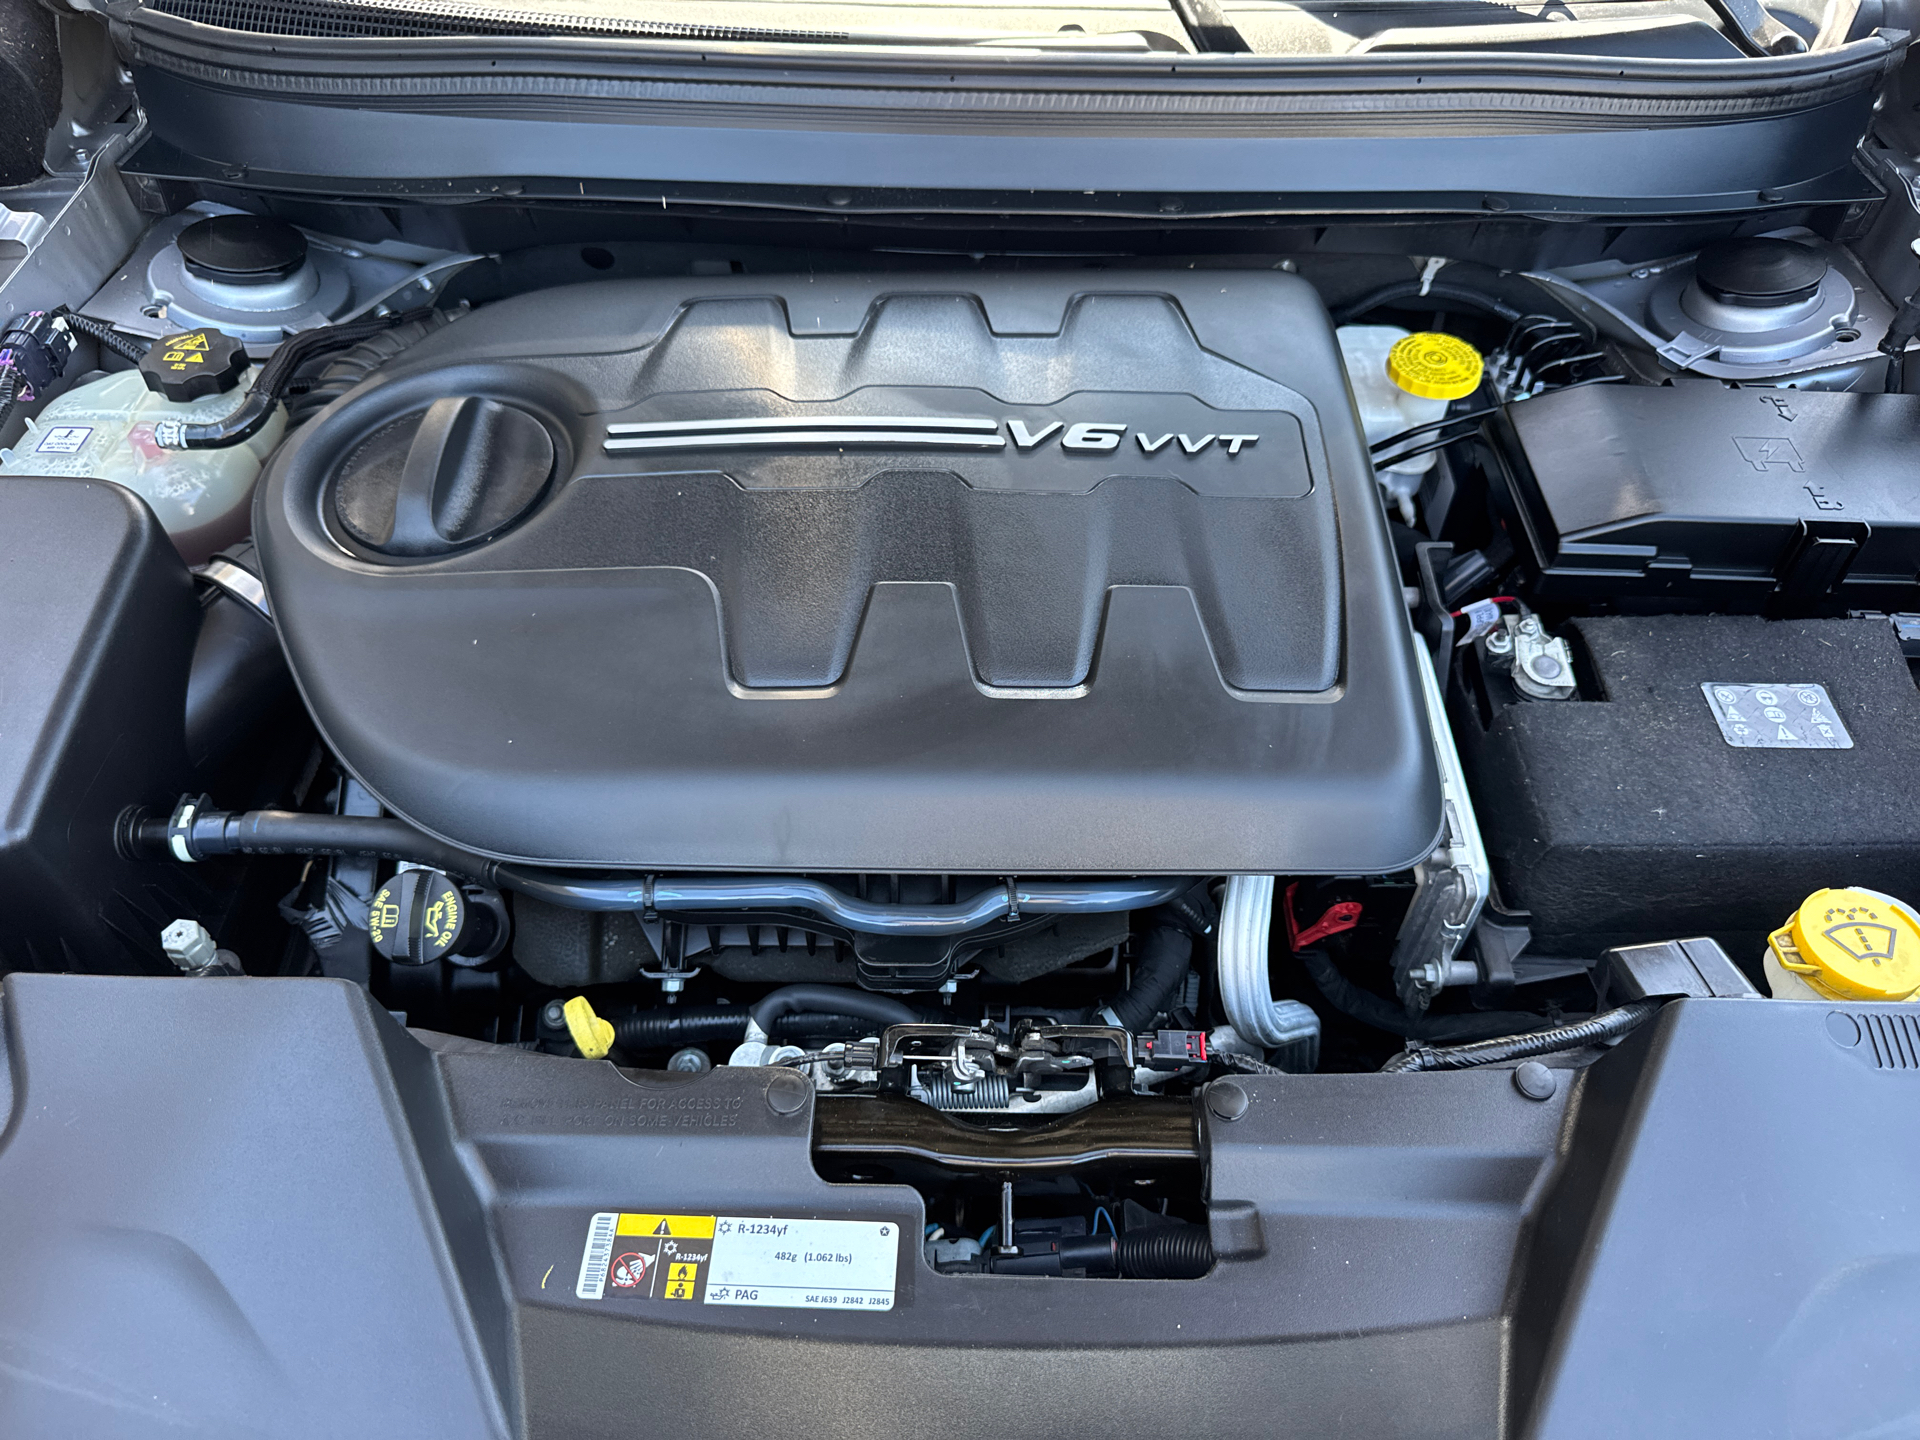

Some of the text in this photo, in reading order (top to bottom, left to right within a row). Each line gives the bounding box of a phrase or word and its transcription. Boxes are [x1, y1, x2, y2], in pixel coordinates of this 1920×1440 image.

[1006, 420, 1260, 455] V6 VVT
[369, 888, 391, 943] SAE 5W-20
[433, 890, 458, 948] ENGINE OIL
[594, 1098, 635, 1110] PANEL
[640, 1098, 666, 1110] FOR
[668, 1098, 721, 1110] ACCESS
[724, 1097, 741, 1110] TO
[604, 1114, 628, 1126] ON
[629, 1114, 668, 1127] SOME
[672, 1114, 737, 1127] VEHICLES
[737, 1223, 789, 1237] R-1234yf
[675, 1252, 709, 1264] R-1234yf
[774, 1251, 853, 1264] 482g (1.062 lbs)
[734, 1289, 759, 1300] PAG
[804, 1295, 890, 1306] SAE J639 J2842 J2845
